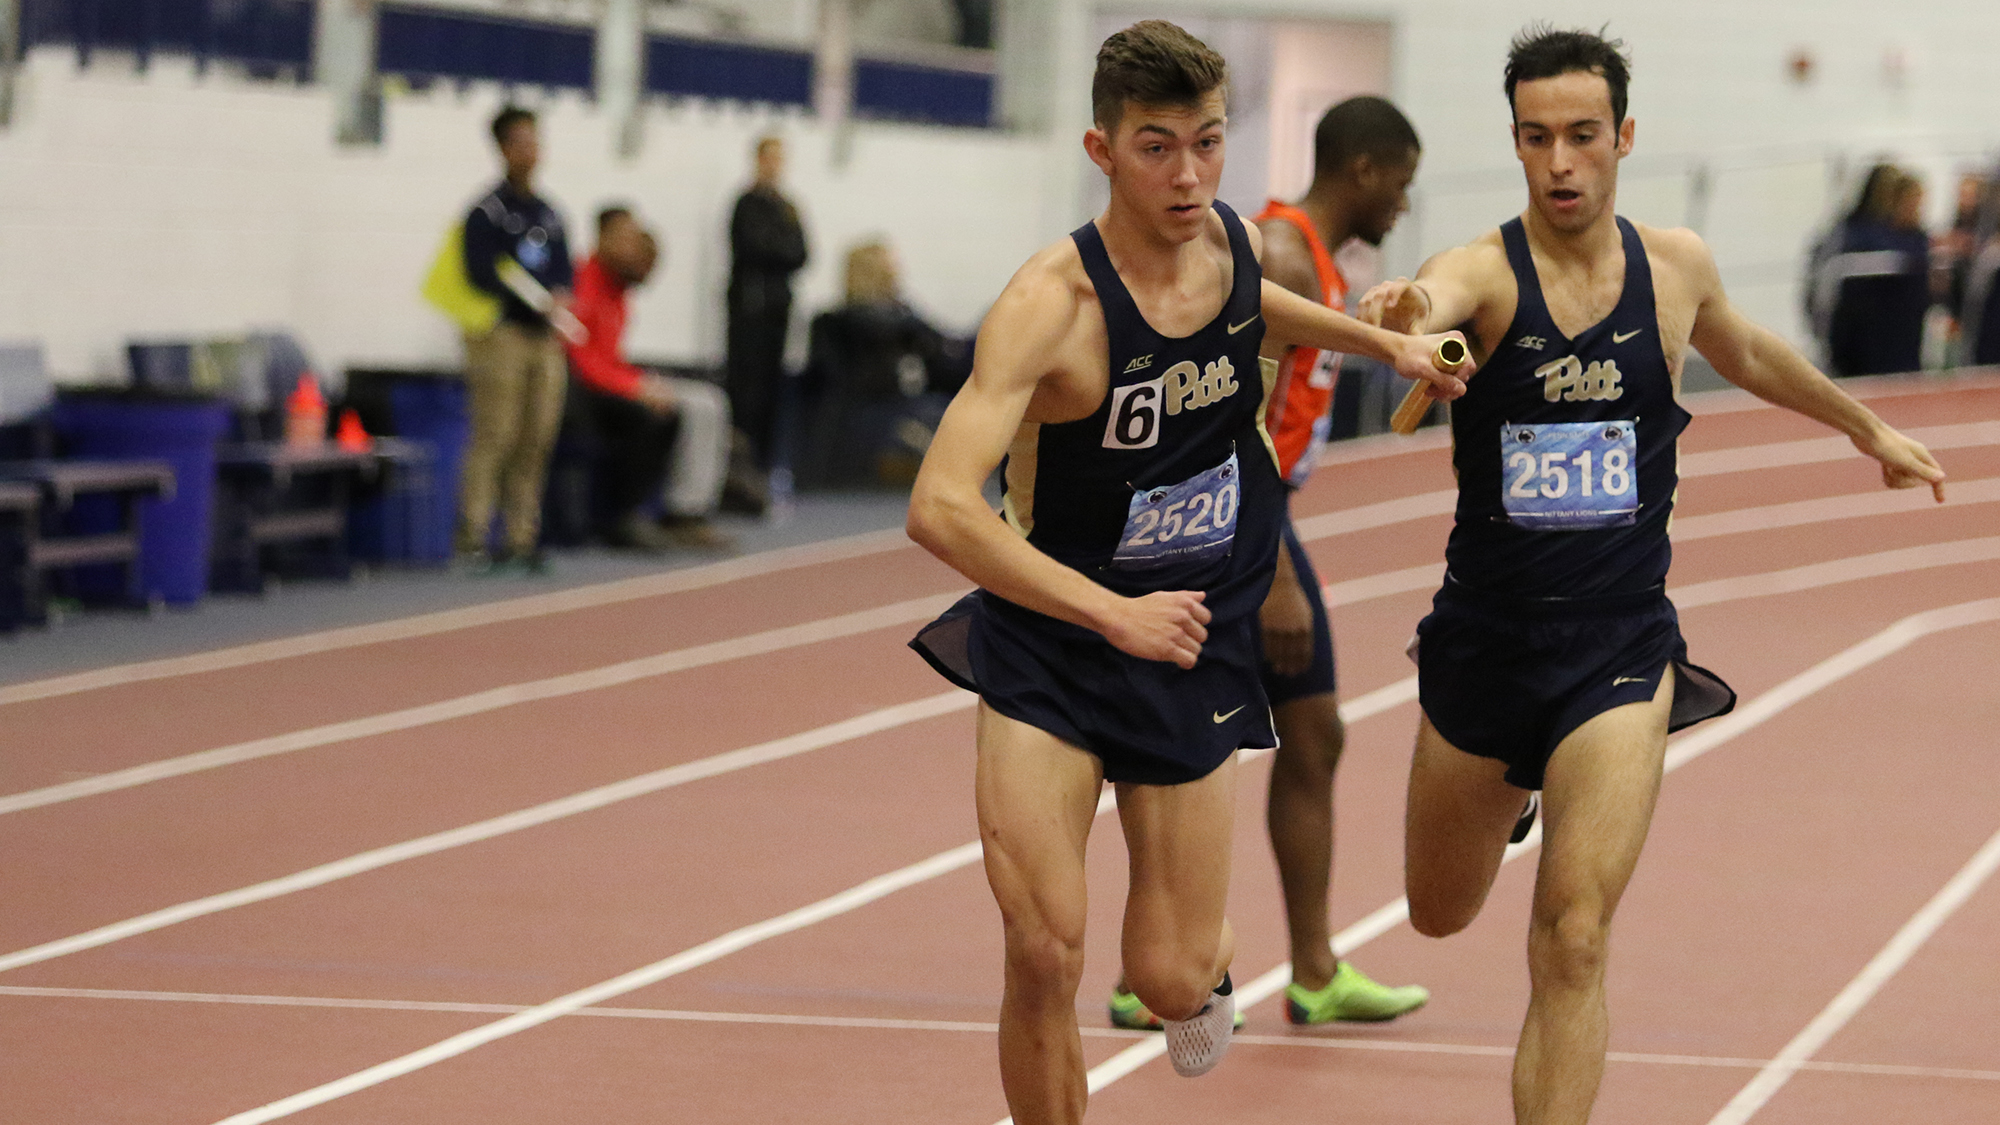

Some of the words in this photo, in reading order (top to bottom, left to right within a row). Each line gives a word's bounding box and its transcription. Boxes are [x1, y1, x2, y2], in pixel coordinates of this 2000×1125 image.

[1124, 354, 1153, 372] ACC
[1516, 335, 1546, 350] ACC
[1160, 355, 1239, 415] Pitt
[1534, 354, 1623, 402] Pitt
[1114, 386, 1156, 446] 6
[1508, 448, 1630, 499] 2518
[1126, 484, 1237, 547] 2520
